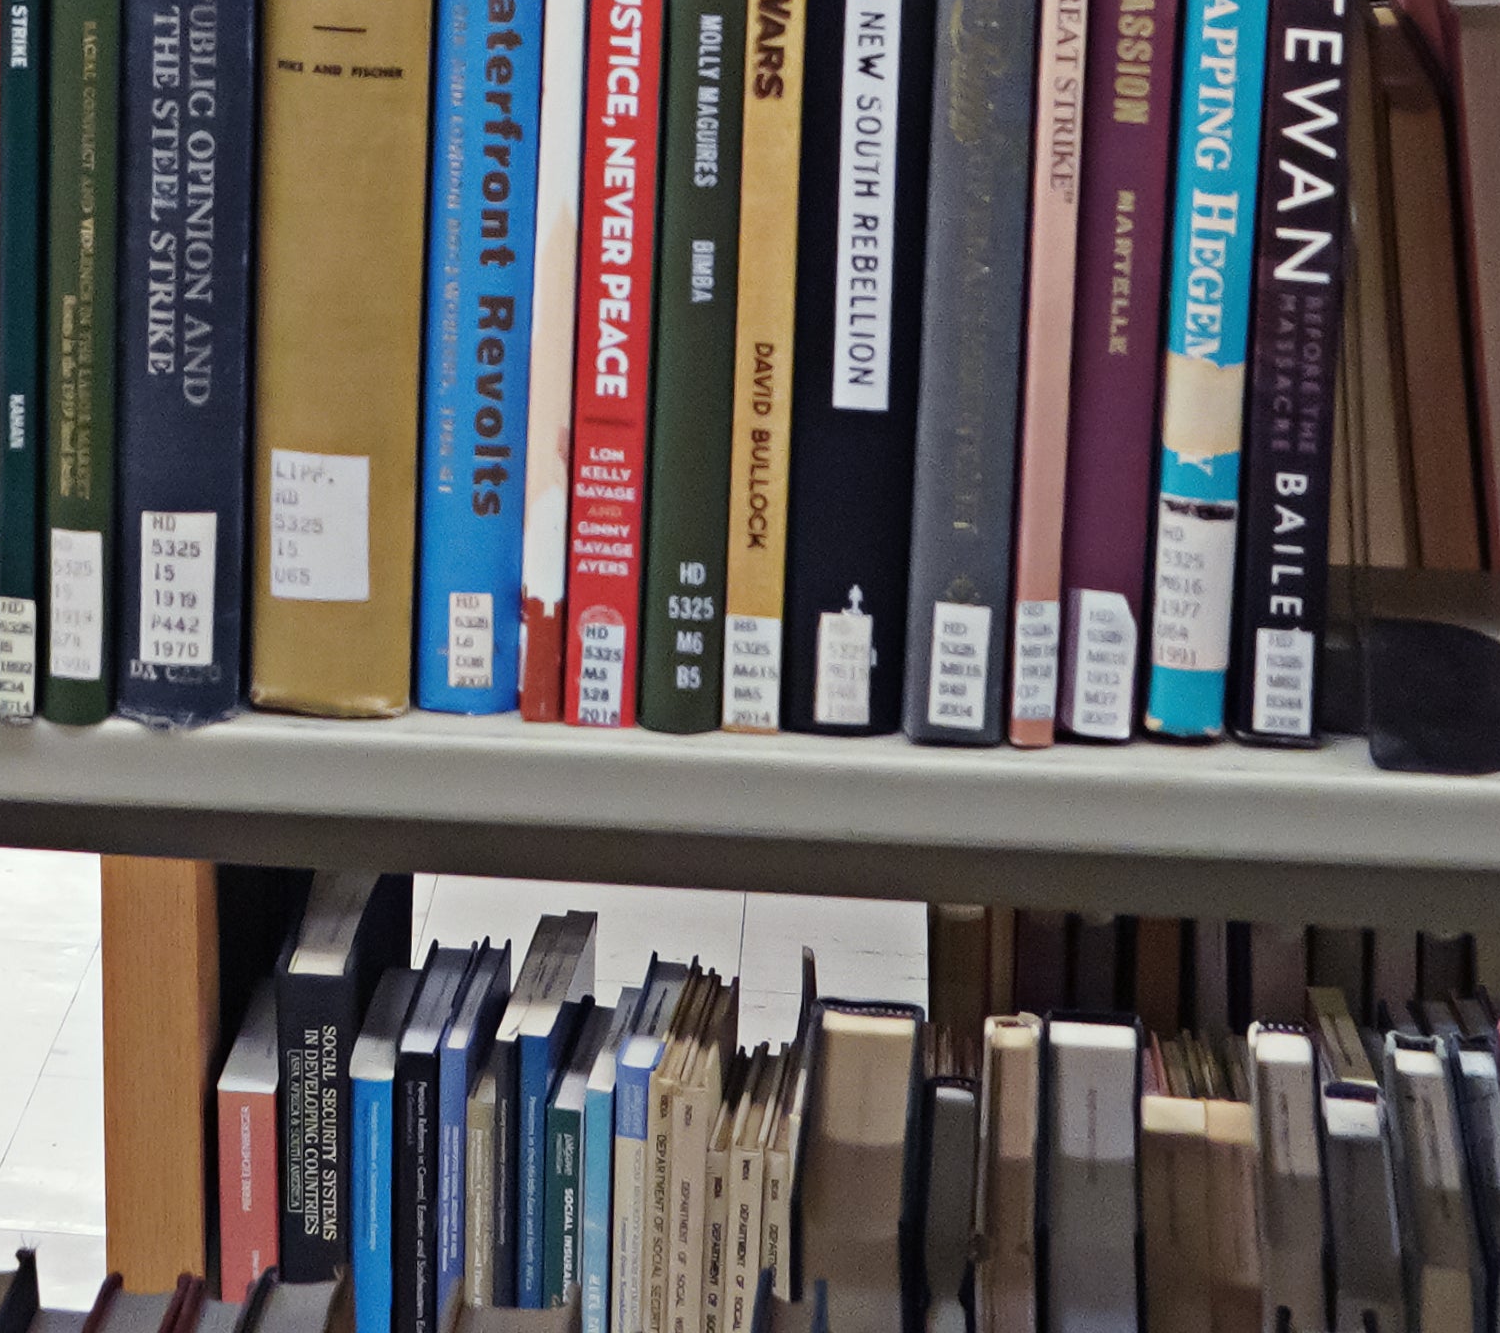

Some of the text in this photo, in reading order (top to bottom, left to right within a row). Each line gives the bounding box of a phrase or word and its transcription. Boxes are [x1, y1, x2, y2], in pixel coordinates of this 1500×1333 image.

[10, 5, 28, 69] STRIKE
[694, 13, 723, 189] MOLLY MAGUIRES
[856, 11, 886, 81] NEW
[147, 5, 181, 376] THE STEEL STRIKE
[184, 129, 216, 304] OPINION
[600, 137, 637, 265] NEVER
[853, 93, 885, 199] SOUTH
[595, 275, 632, 399] PEACE
[691, 239, 715, 303] BIMBA
[847, 213, 880, 387] REBELLION
[182, 315, 212, 407] AND
[472, 296, 516, 518] Revolts
[747, 342, 775, 550] DAVID BULLOCK
[303, 1029, 319, 1235] IN DEVELOPING COUNTRIES
[322, 1025, 338, 1241] SOCIAL SECURITY SYSTEMS
